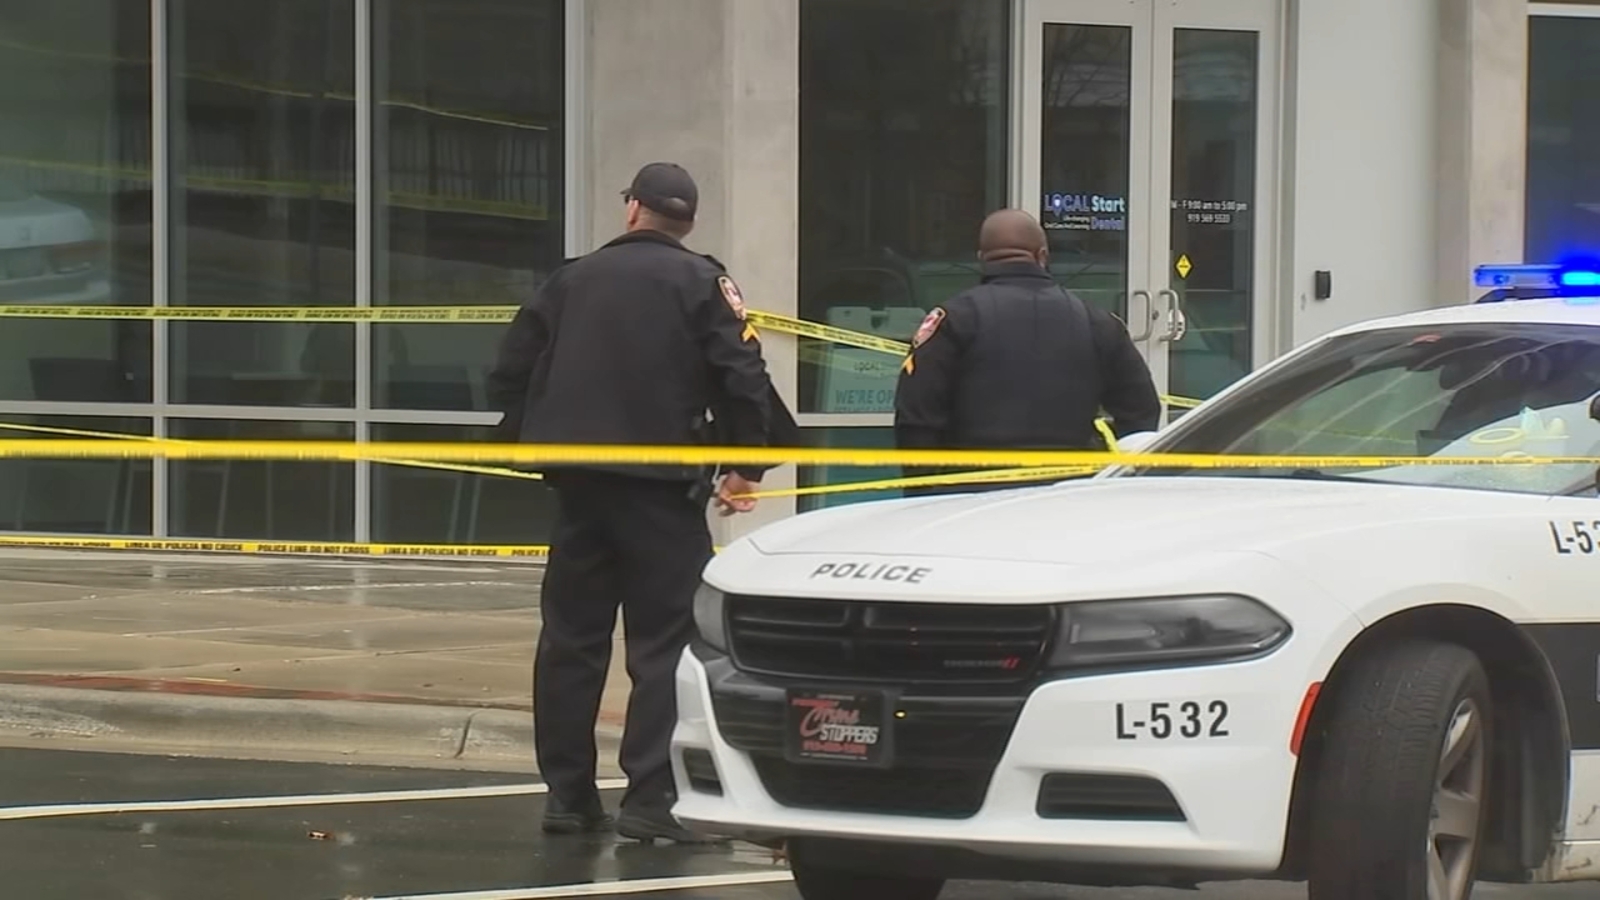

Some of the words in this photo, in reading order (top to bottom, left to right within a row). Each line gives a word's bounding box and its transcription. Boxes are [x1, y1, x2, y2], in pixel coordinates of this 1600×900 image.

[1045, 194, 1090, 214] LOCAL
[1091, 195, 1125, 212] Start
[1236, 203, 1248, 212] pm
[1091, 216, 1125, 230] Dental
[835, 389, 874, 405] WE'RE
[258, 544, 287, 553] POLICE
[288, 544, 308, 553] LINE
[309, 545, 322, 553] DO
[323, 545, 341, 554] NOT
[342, 546, 371, 555] CROSS
[809, 563, 933, 584] POLICE
[1115, 699, 1229, 740] L-532
[819, 724, 880, 745] STOPPERS
